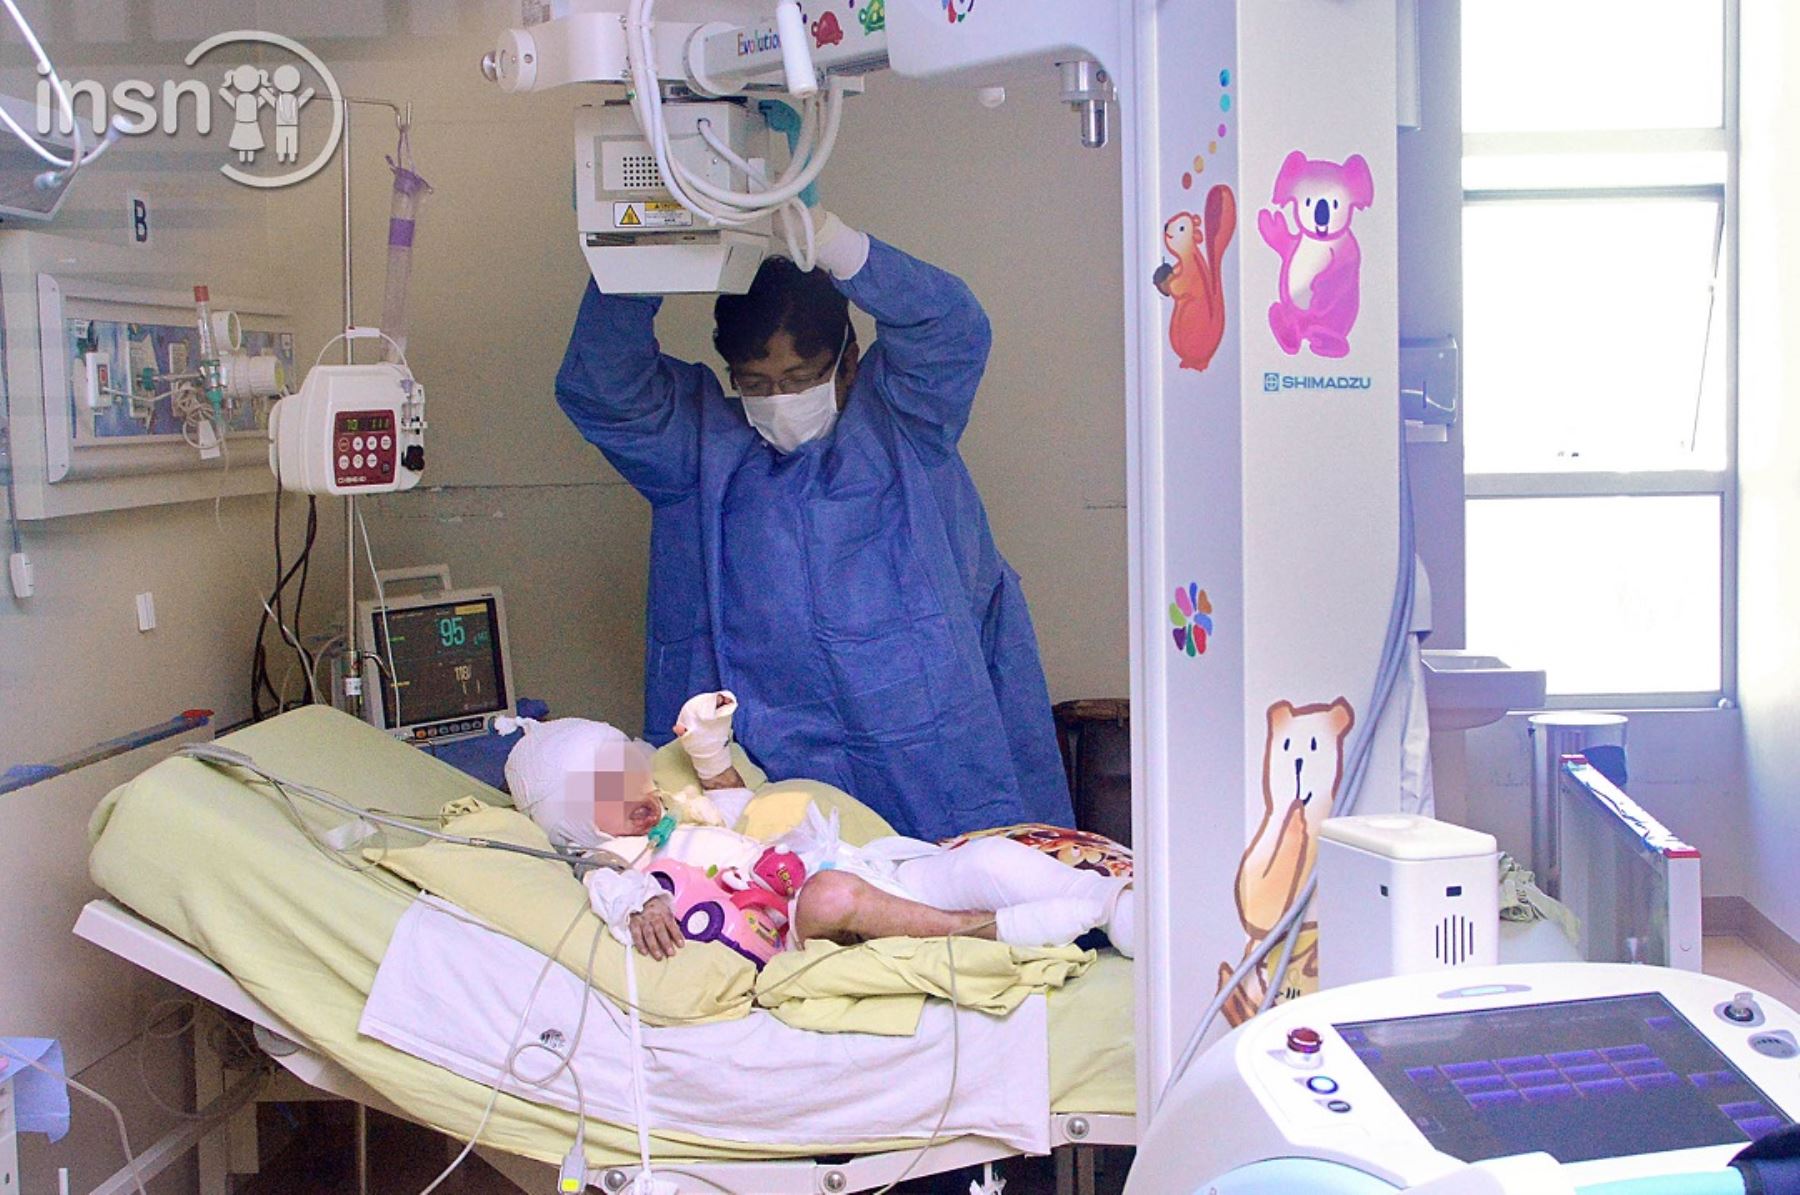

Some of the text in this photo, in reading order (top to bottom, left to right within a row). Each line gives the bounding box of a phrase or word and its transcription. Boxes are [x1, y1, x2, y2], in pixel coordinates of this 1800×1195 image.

[737, 27, 783, 57] Evolutio
[133, 198, 148, 243] B
[1282, 375, 1372, 389] SHIMADZU
[439, 616, 466, 647] 95
